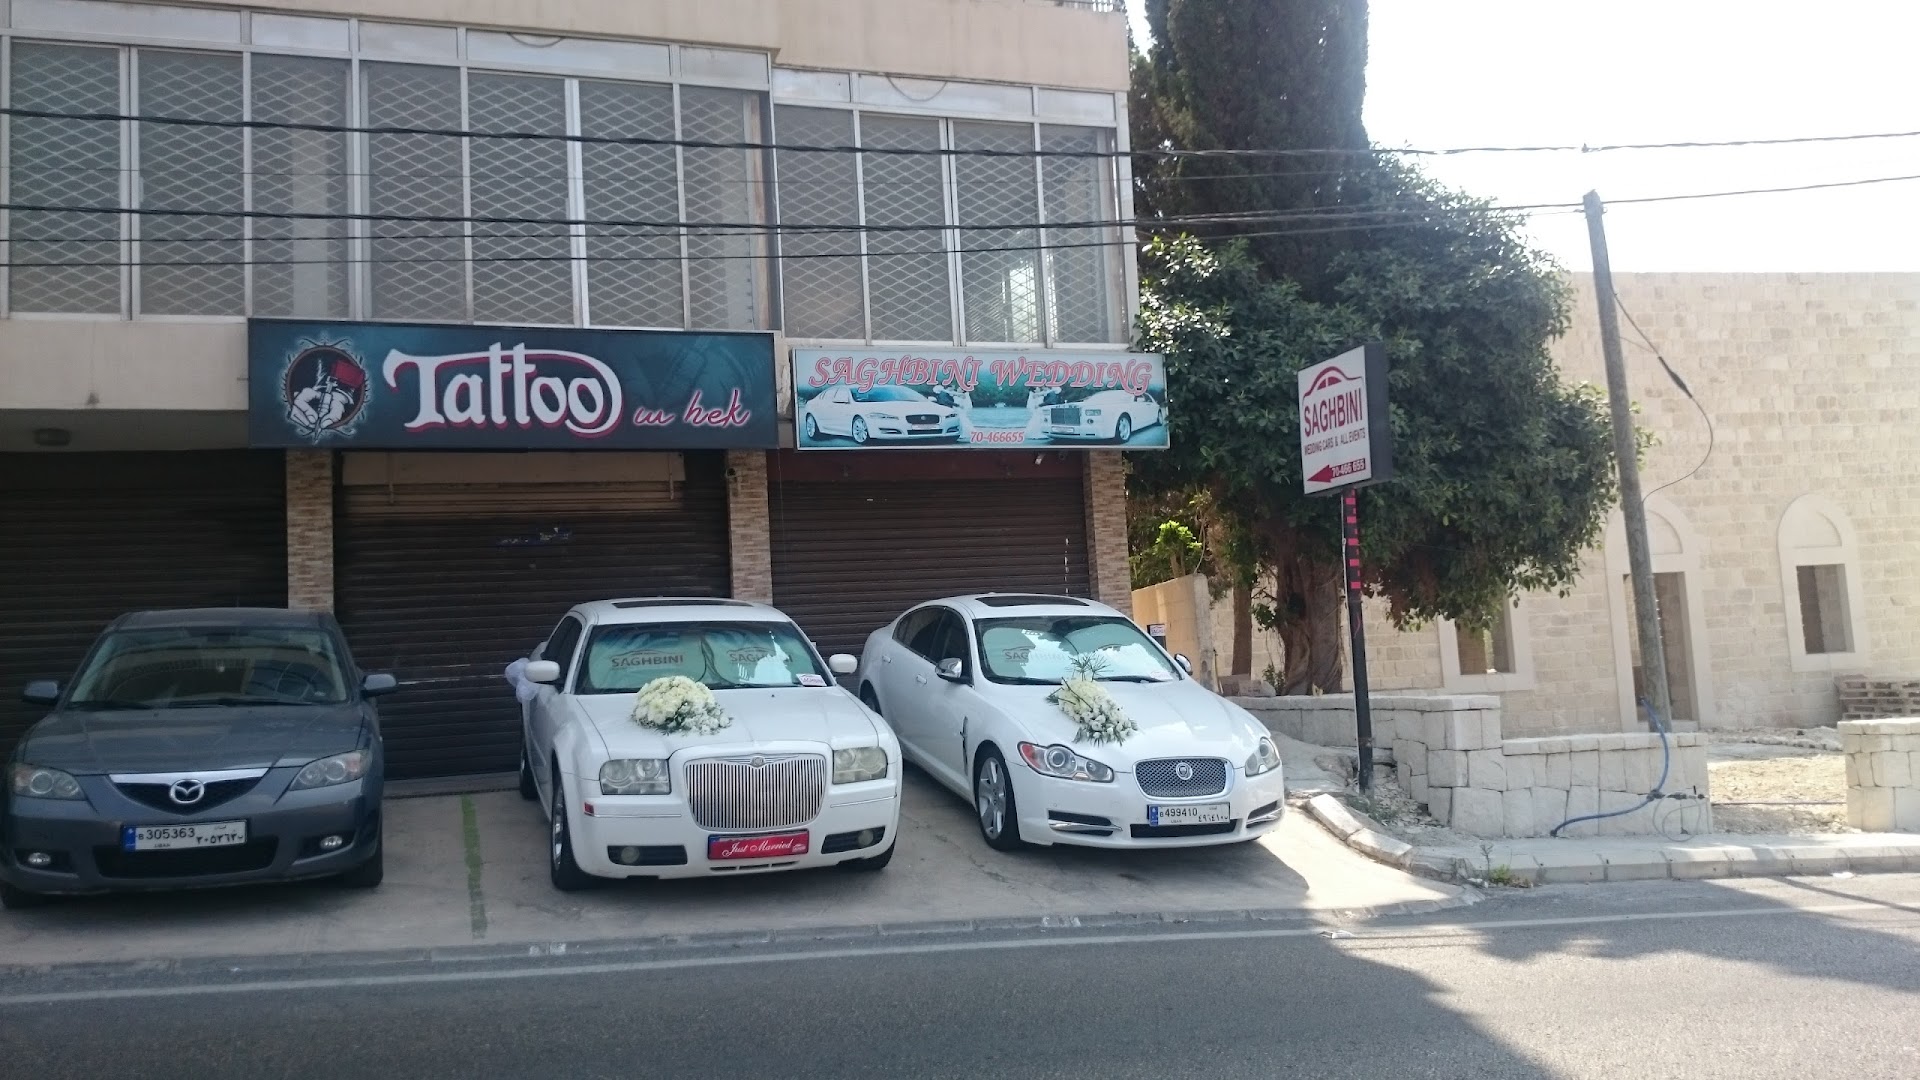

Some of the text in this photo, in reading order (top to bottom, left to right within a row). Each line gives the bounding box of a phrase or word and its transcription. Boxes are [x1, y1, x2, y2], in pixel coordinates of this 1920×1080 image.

[808, 355, 1153, 395] SAGHBINI WEDDING
[383, 342, 623, 437] Tattoo
[683, 388, 750, 428] hek
[1304, 388, 1363, 437] SAGHBINI
[970, 431, 1025, 443] 70-466655
[1322, 437, 1334, 451] CARS
[1340, 432, 1349, 445] ALL
[1349, 427, 1366, 443] EVENTS
[611, 654, 684, 667] SAGHBINI
[1165, 807, 1198, 817] 499410
[146, 827, 196, 841] 305363
[722, 842, 748, 857] Just
[750, 839, 794, 852] Married
